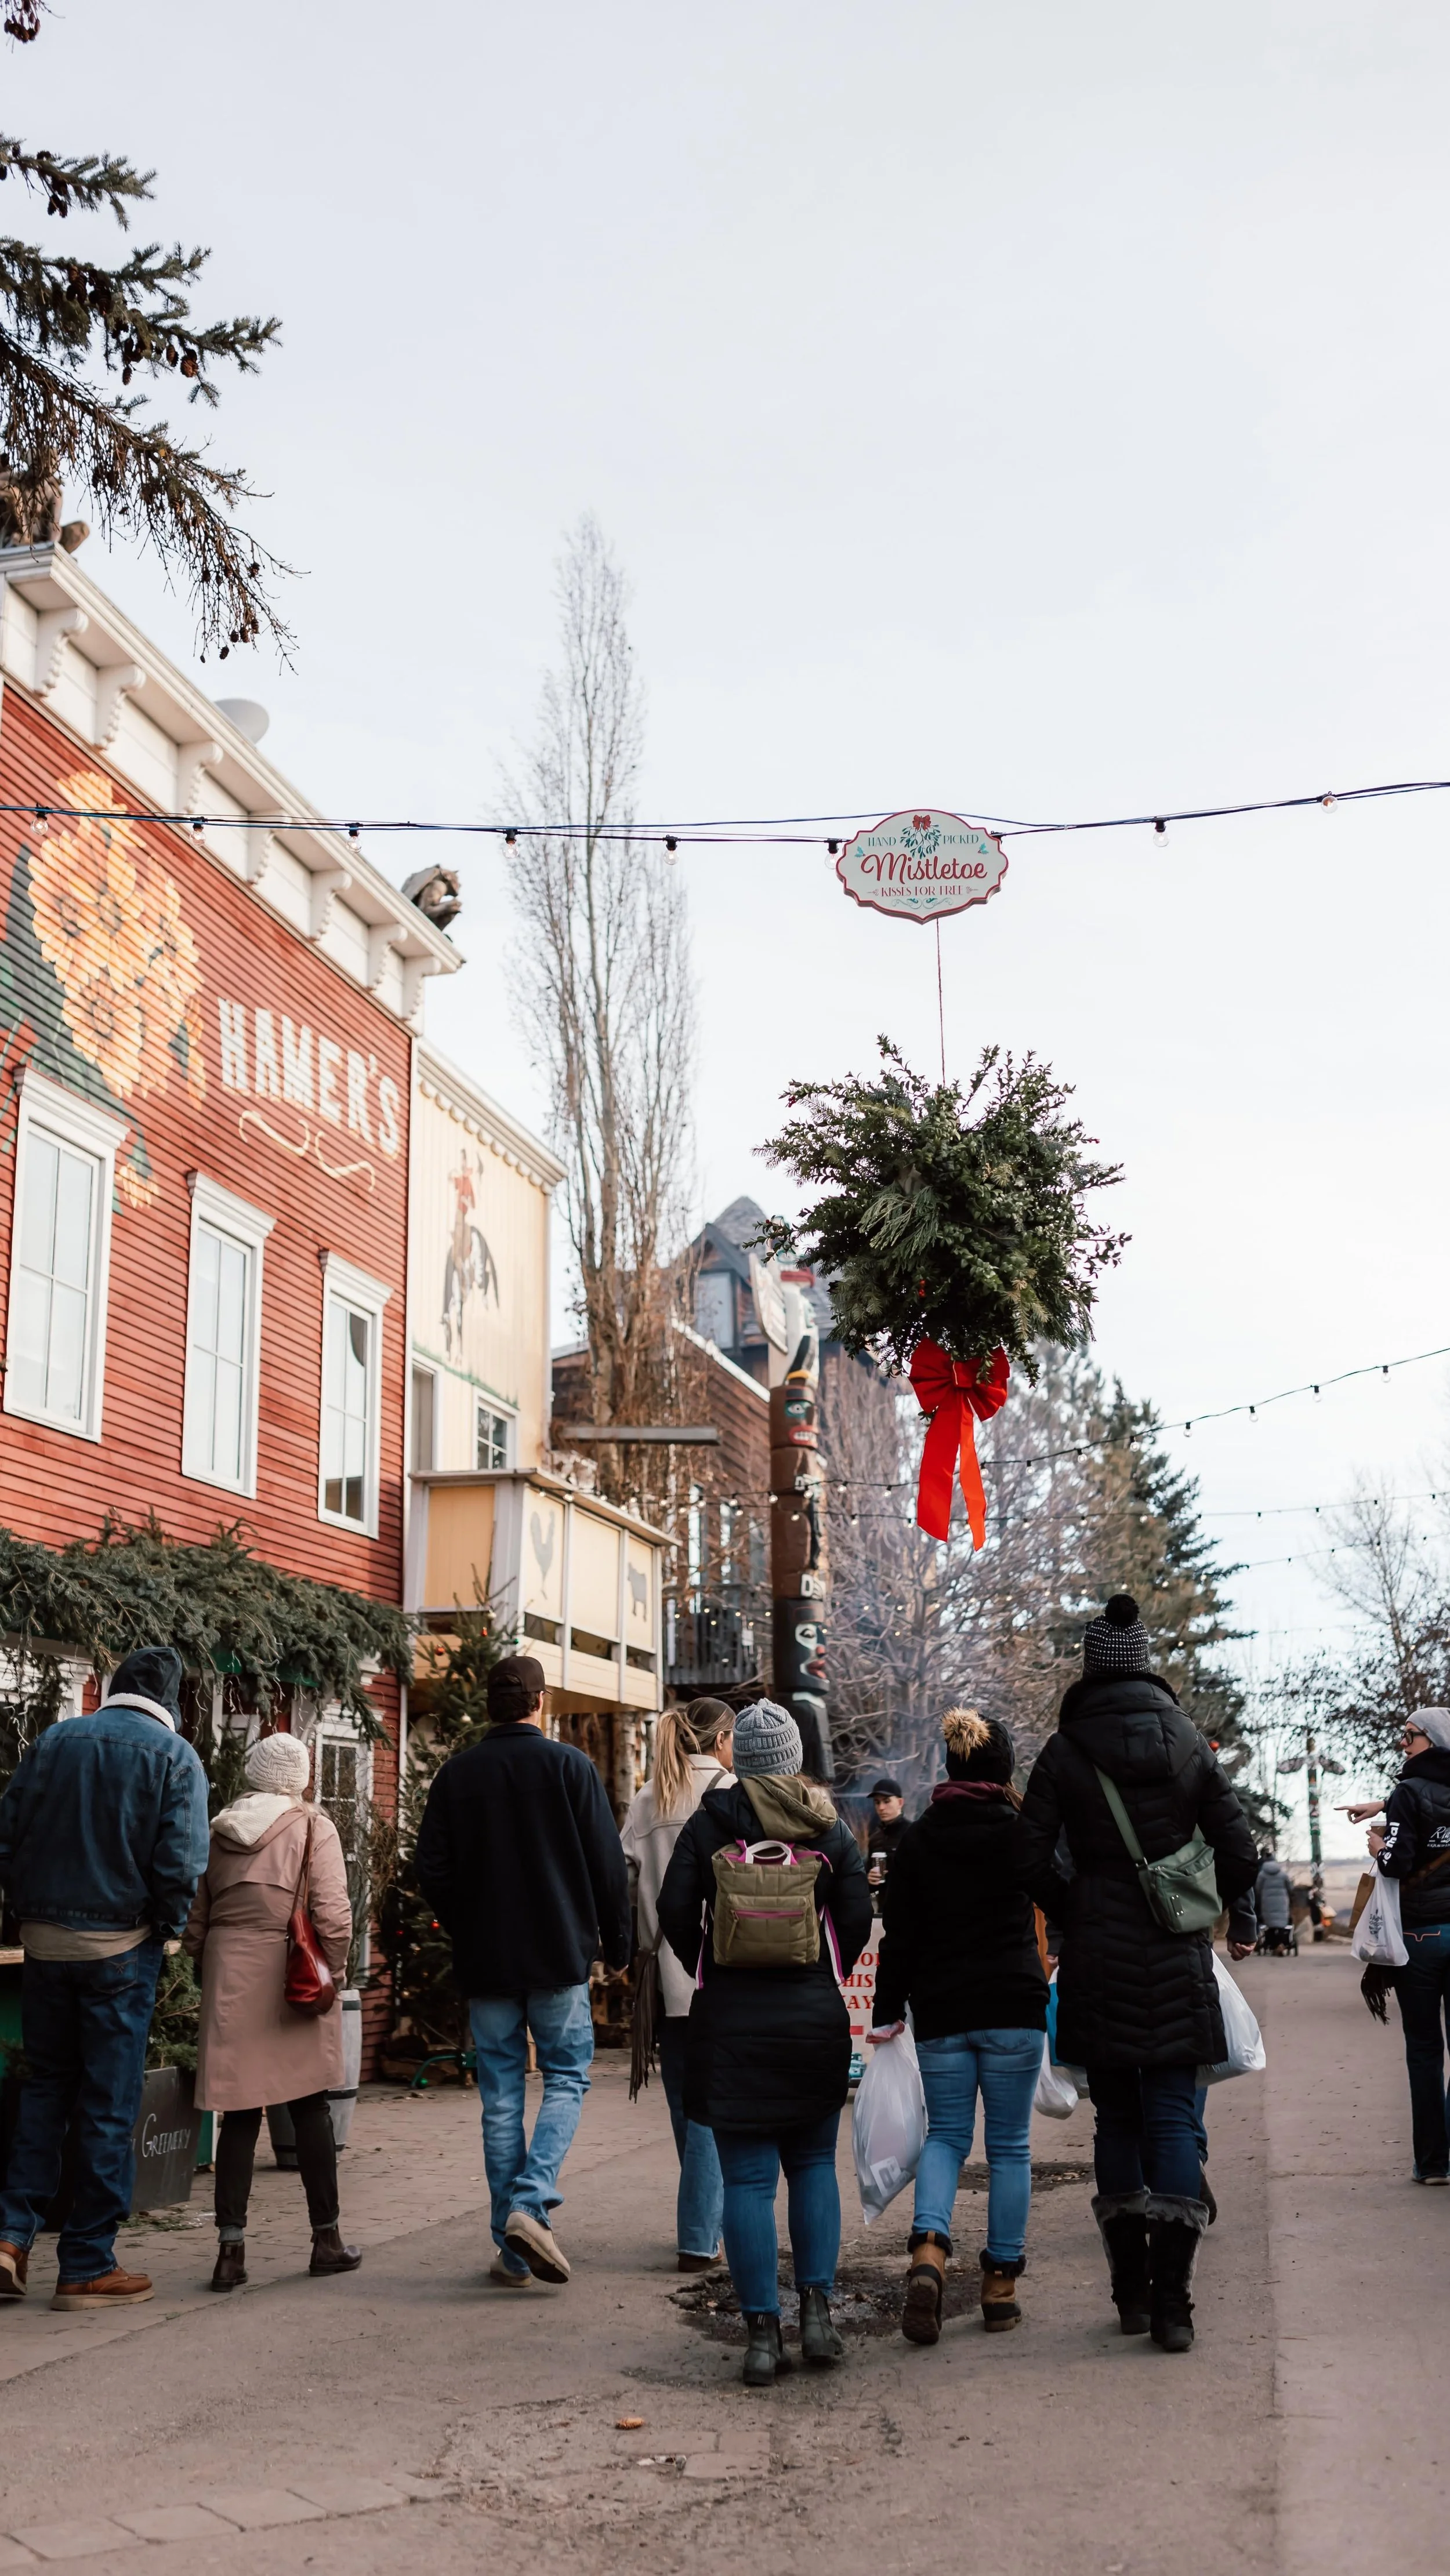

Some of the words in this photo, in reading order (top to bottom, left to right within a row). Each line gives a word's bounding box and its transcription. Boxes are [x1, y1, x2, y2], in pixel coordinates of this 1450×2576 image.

[869, 836, 897, 847] HAND
[943, 834, 979, 844] PICKED
[861, 852, 988, 884] Mistletoe
[881, 887, 911, 897] KISSES
[915, 886, 936, 896] FOR
[940, 884, 963, 895] FREE
[217, 996, 400, 1160] HAMER'S
[842, 1995, 875, 2009] AY
